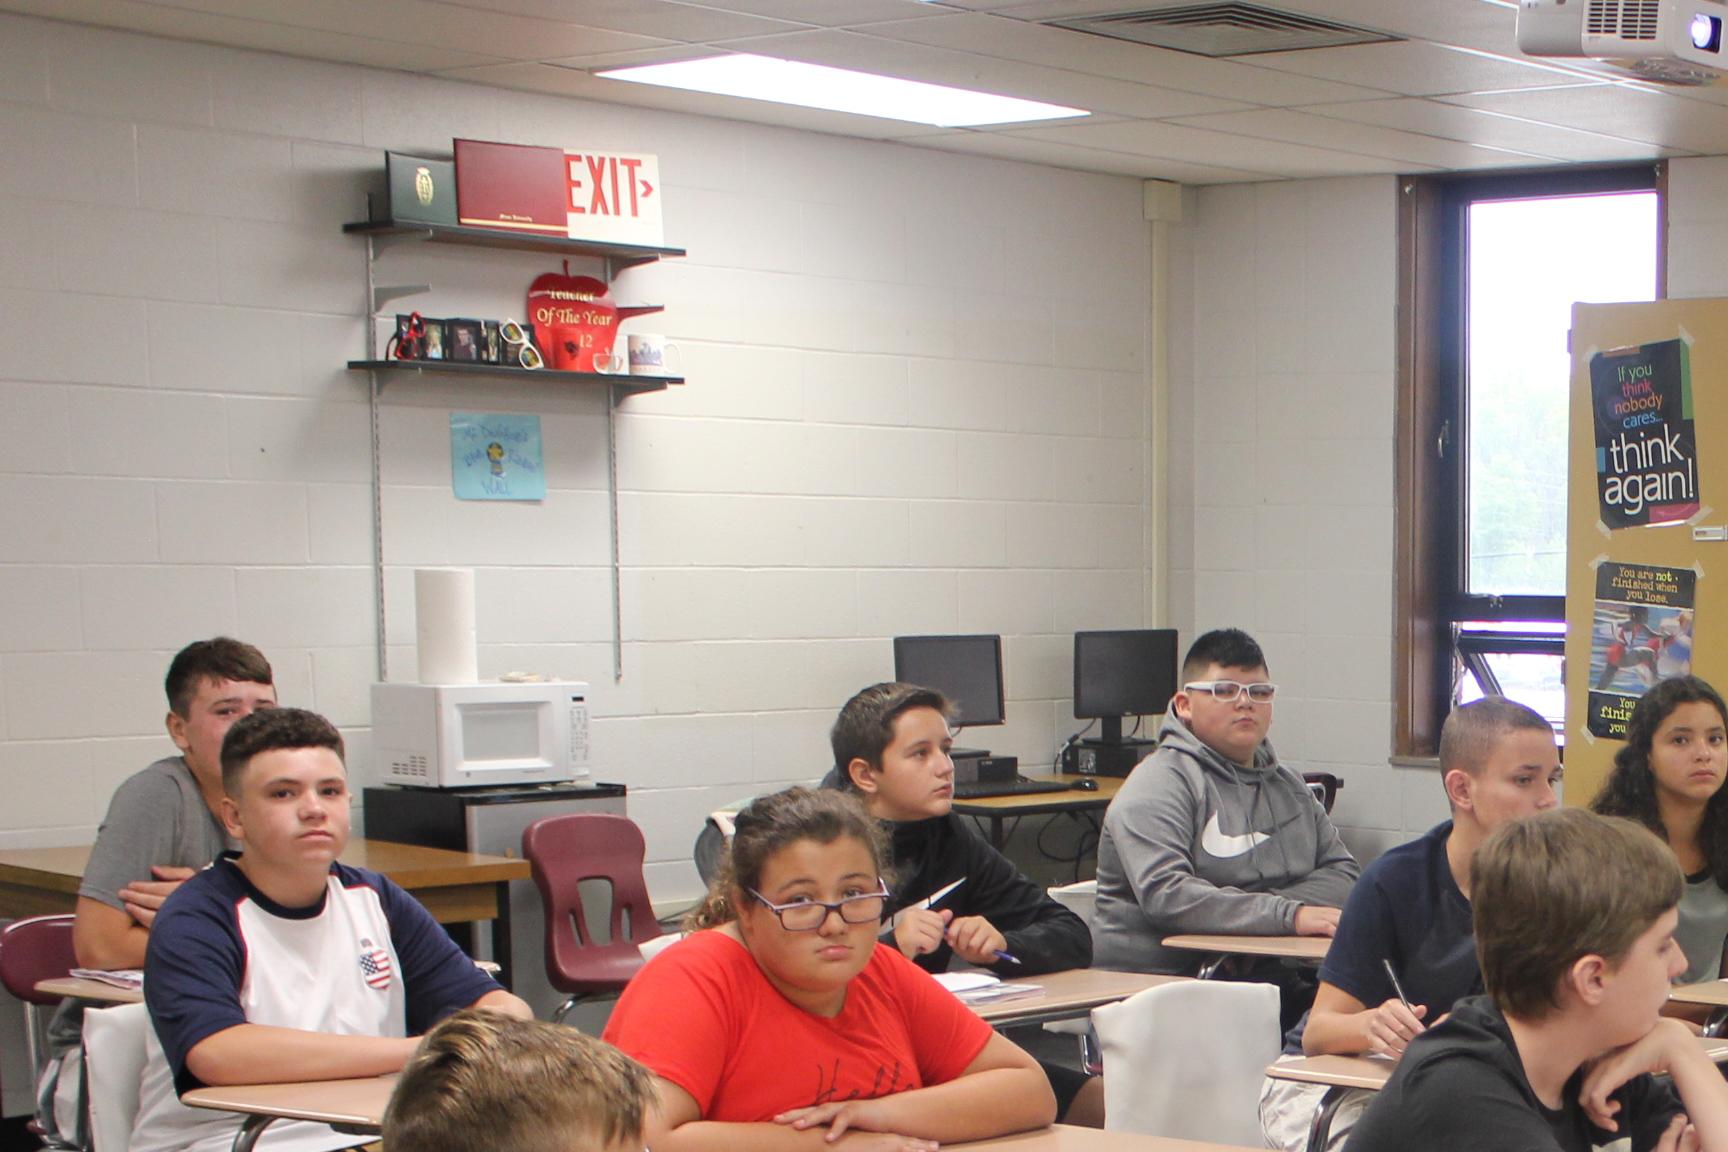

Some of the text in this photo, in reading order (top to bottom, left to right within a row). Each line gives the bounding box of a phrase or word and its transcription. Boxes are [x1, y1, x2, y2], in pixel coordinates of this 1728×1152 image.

[564, 154, 642, 217] EXIT
[537, 308, 613, 327] Of The Year
[1617, 364, 1653, 384] If you
[1622, 379, 1653, 398] think
[1614, 392, 1663, 415] nobody
[1610, 423, 1685, 474] think
[1604, 458, 1694, 516] again!
[1619, 567, 1673, 582] You are not
[1611, 577, 1679, 593] finished when
[1626, 590, 1643, 600] you
[1619, 697, 1636, 709] You
[1600, 705, 1632, 721] finis
[1609, 723, 1626, 734] you
